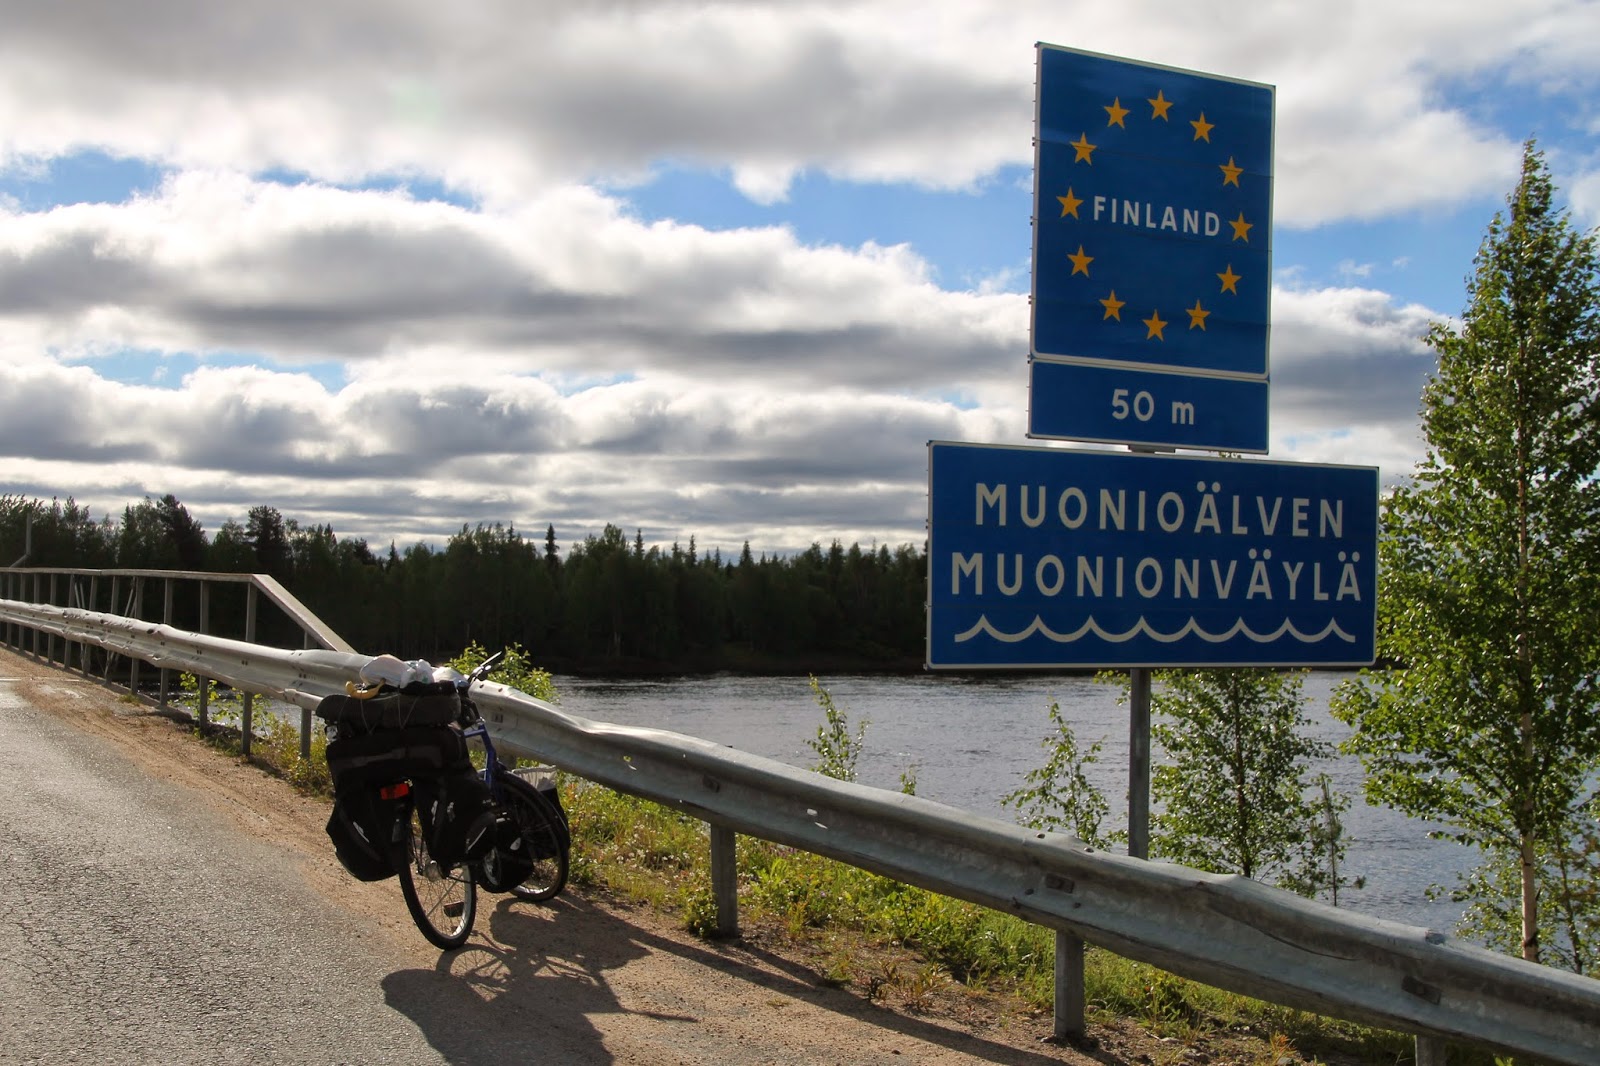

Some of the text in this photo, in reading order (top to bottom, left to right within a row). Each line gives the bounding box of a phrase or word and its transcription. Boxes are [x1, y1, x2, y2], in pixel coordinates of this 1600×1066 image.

[1093, 196, 1220, 237] FINLAND
[1111, 389, 1195, 426] 50 m
[975, 481, 1343, 538] MUONIOÄLVEN
[951, 548, 1361, 602] MUONIONVÄYLÄ
